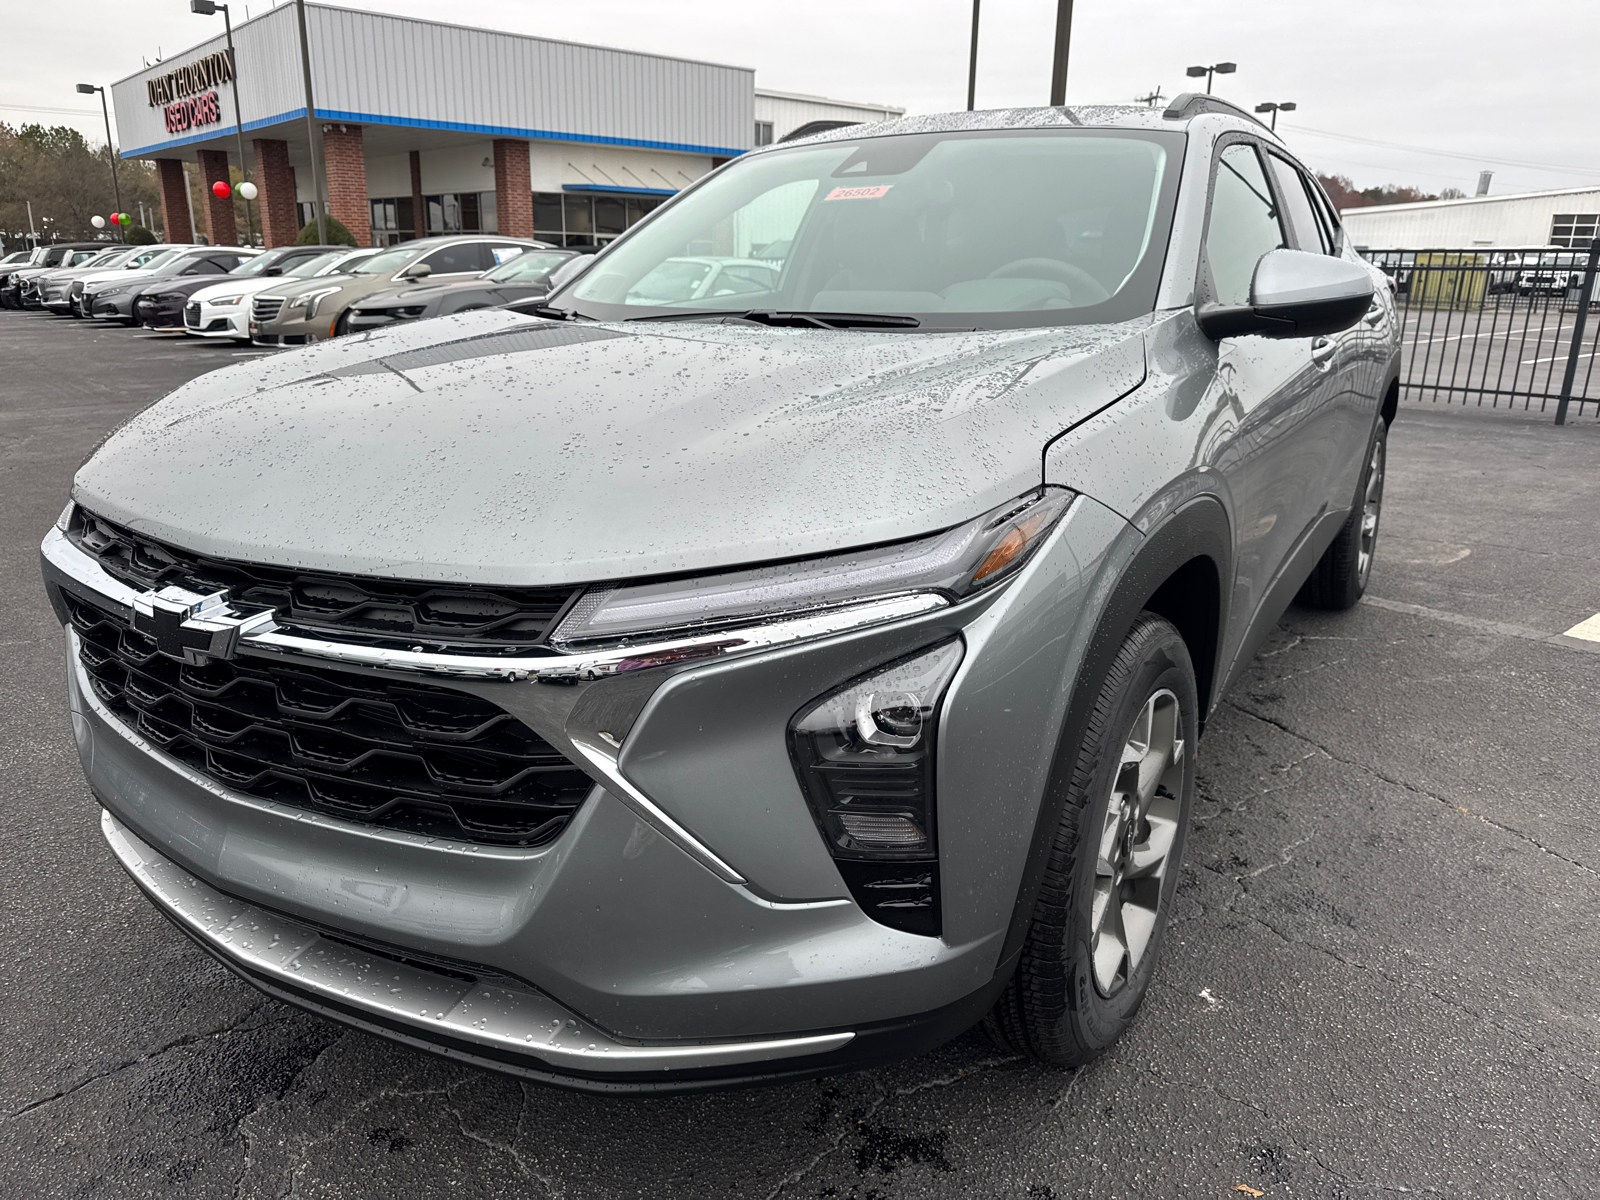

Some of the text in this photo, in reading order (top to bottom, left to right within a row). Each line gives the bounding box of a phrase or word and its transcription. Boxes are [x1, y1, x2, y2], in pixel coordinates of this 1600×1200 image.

[146, 49, 234, 107] JOHN THORNTON
[164, 91, 219, 133] USED CARS
[834, 187, 880, 198] 26502
